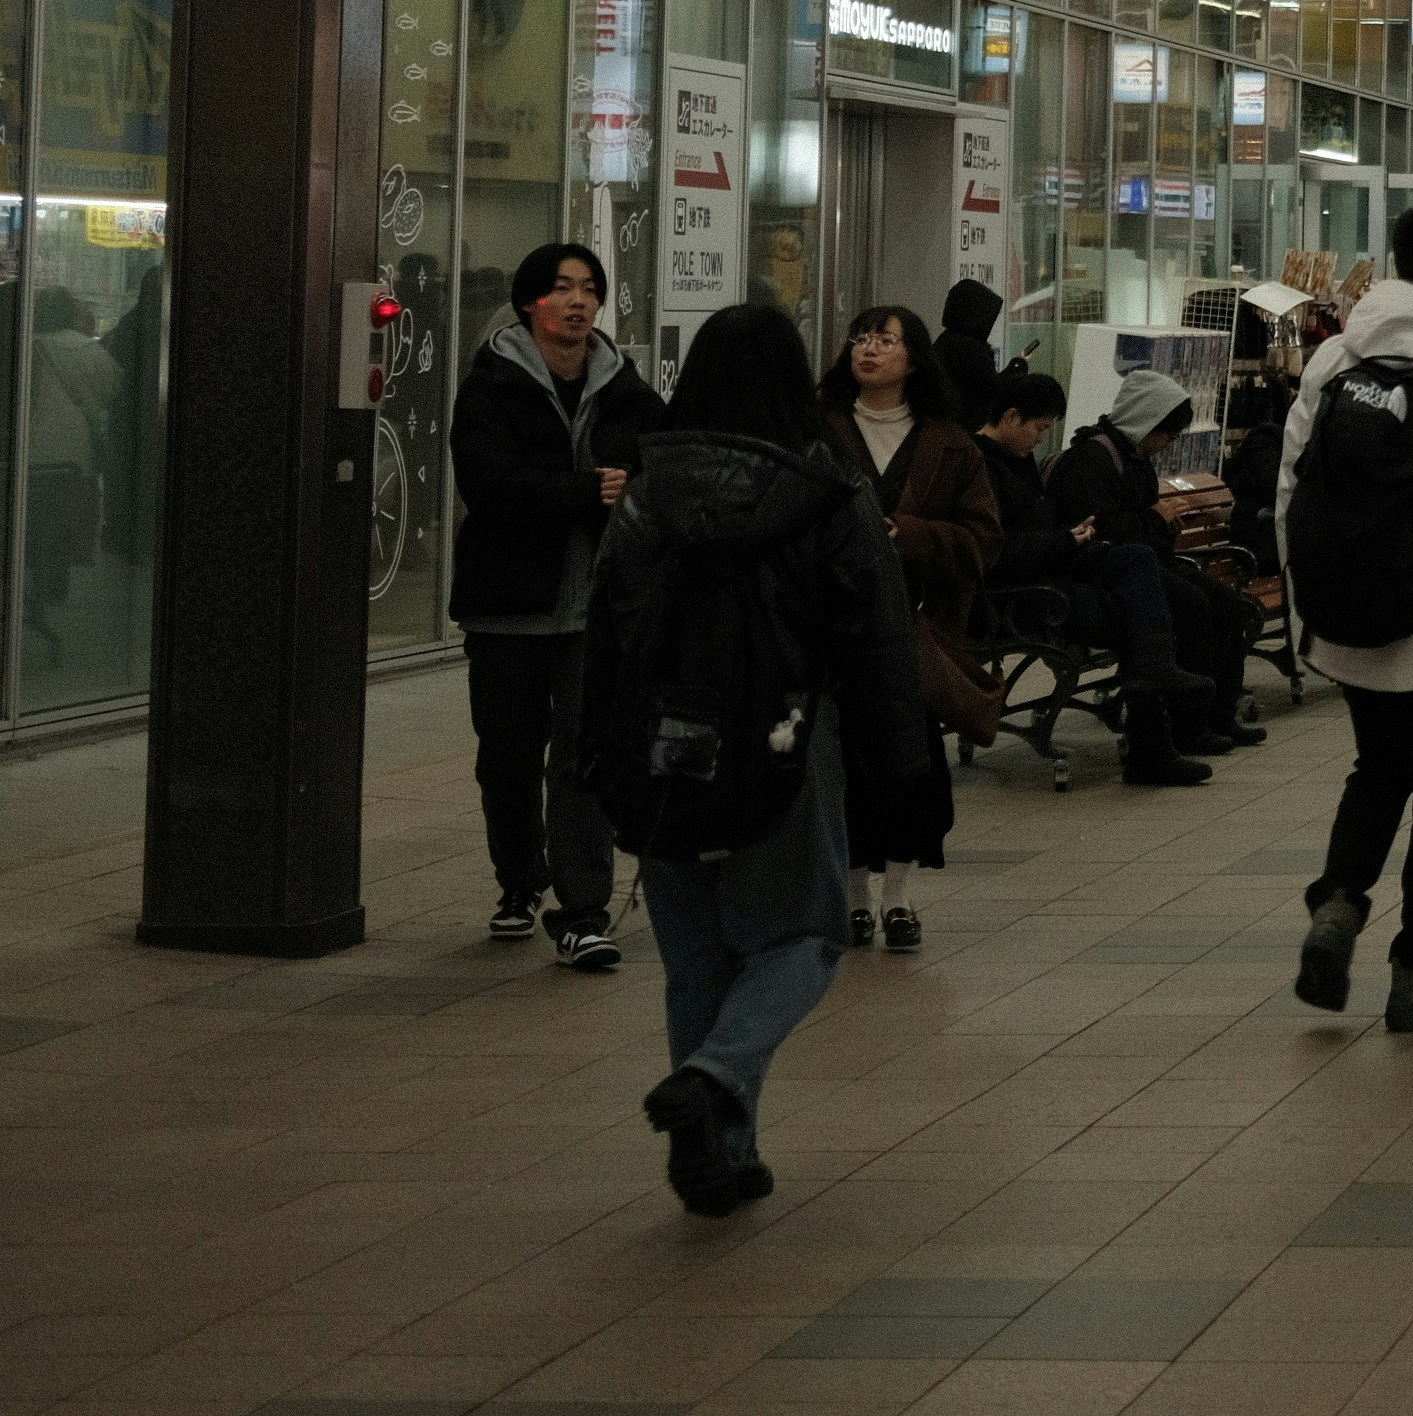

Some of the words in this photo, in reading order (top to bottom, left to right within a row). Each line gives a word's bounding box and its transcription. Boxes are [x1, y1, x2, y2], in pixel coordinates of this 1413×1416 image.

[691, 93, 716, 115] 地下直通
[691, 118, 734, 139] エスカレーター
[674, 149, 701, 169] Entrance
[688, 206, 711, 229] 地下鉄
[673, 251, 694, 276] POLE
[700, 252, 723, 277] TOWN
